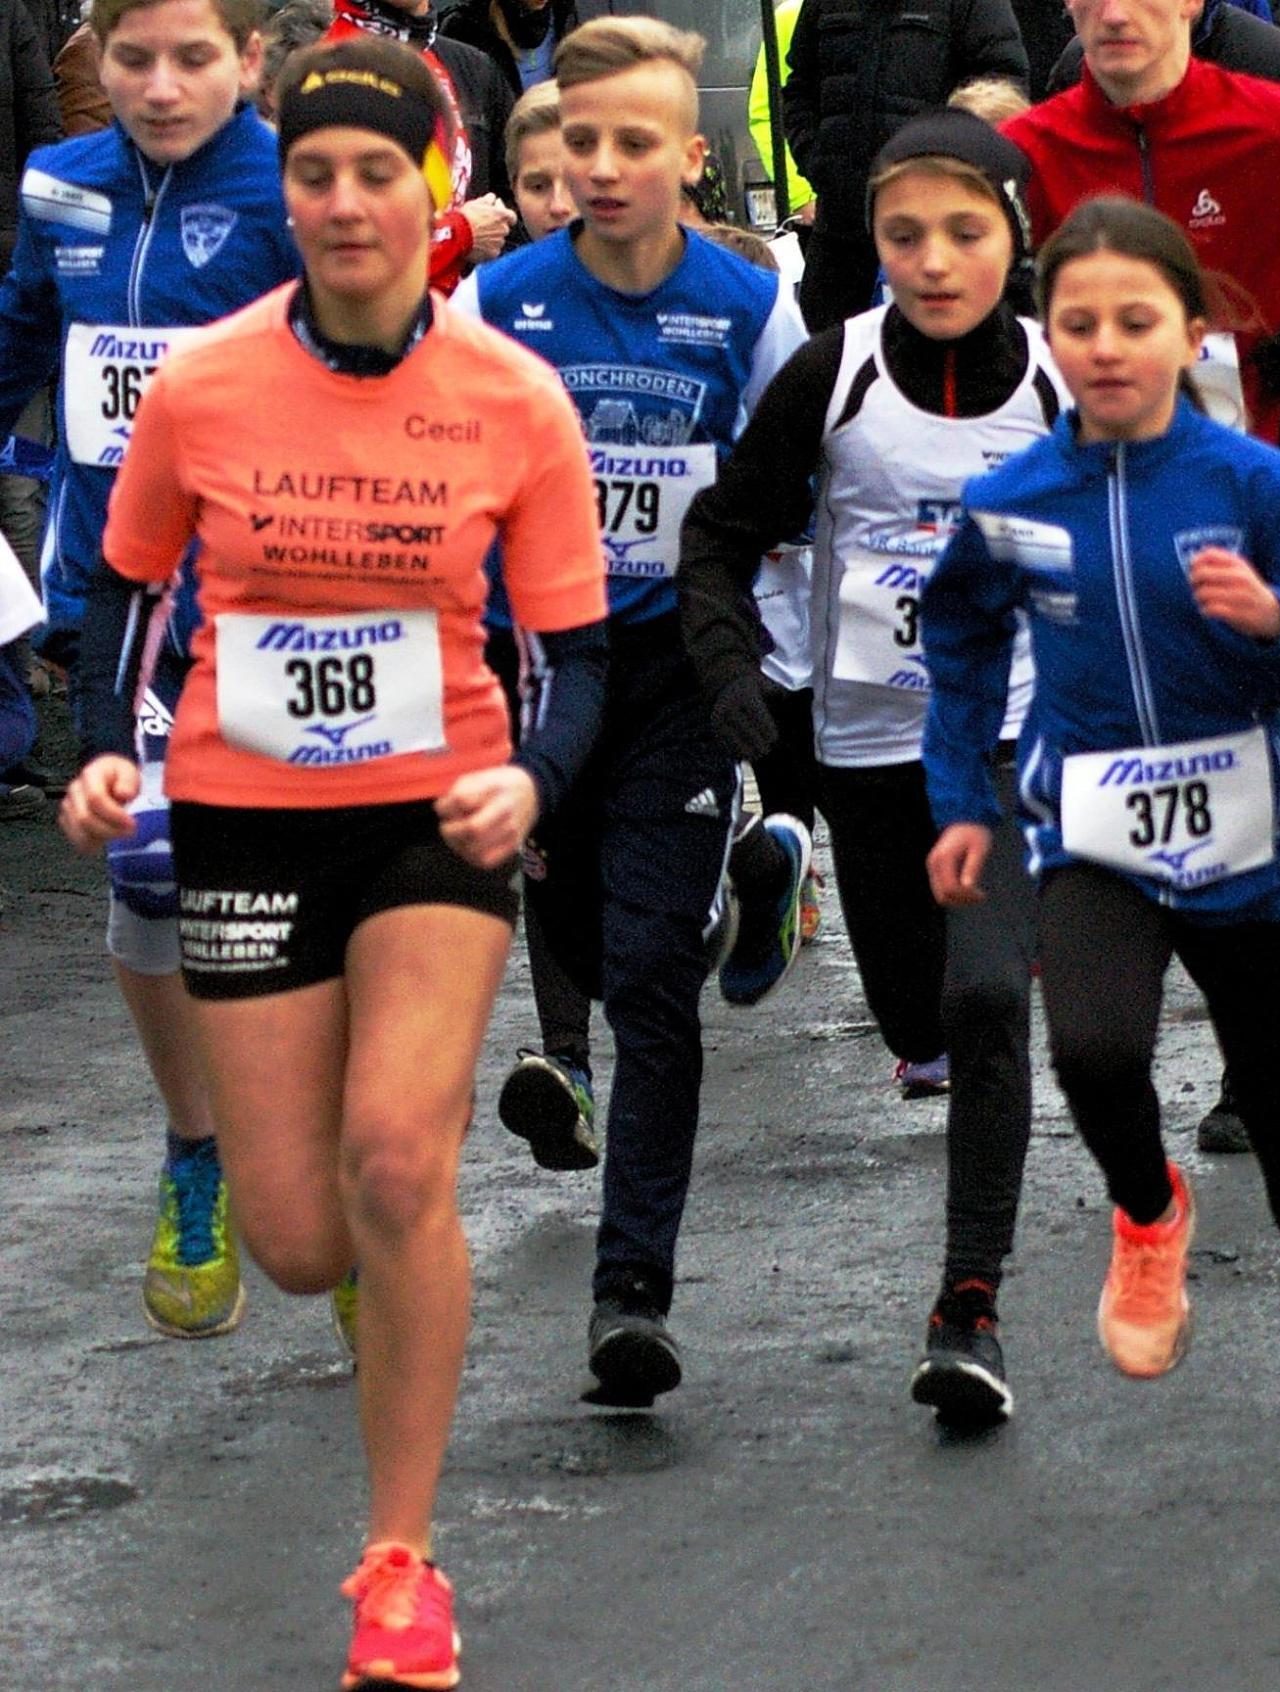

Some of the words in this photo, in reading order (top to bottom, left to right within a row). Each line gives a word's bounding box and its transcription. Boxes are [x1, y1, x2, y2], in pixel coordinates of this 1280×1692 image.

[404, 415, 481, 443] Cecil
[253, 470, 448, 506] LAUFTEAM
[280, 515, 445, 546] INTERSPORT
[263, 545, 428, 570] WOHLLEBEN
[286, 653, 376, 719] 368
[1126, 780, 1212, 848] 378
